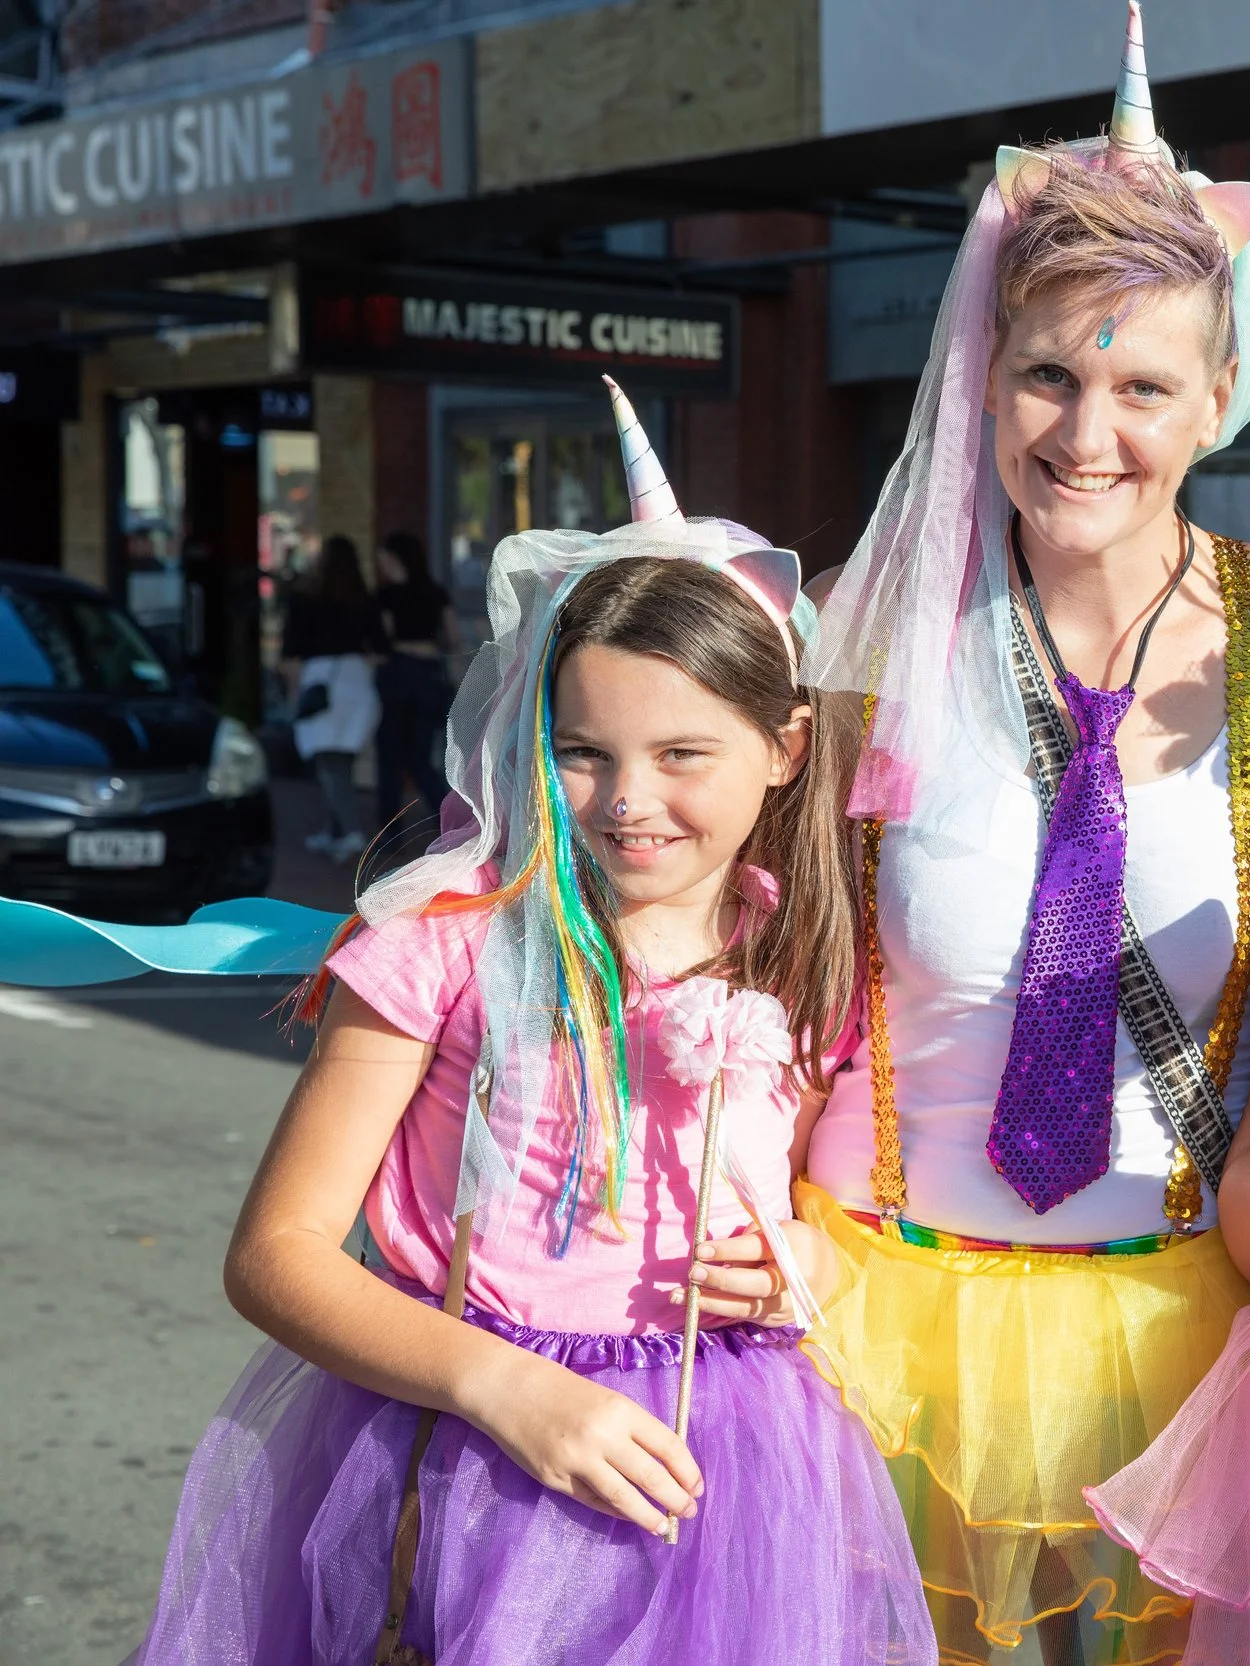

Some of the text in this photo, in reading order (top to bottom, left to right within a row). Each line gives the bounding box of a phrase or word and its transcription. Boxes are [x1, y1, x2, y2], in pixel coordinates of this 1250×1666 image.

[0, 90, 293, 218] TIC CUISINE
[402, 297, 583, 351] MAJESTIC
[590, 313, 723, 361] CUISINE
